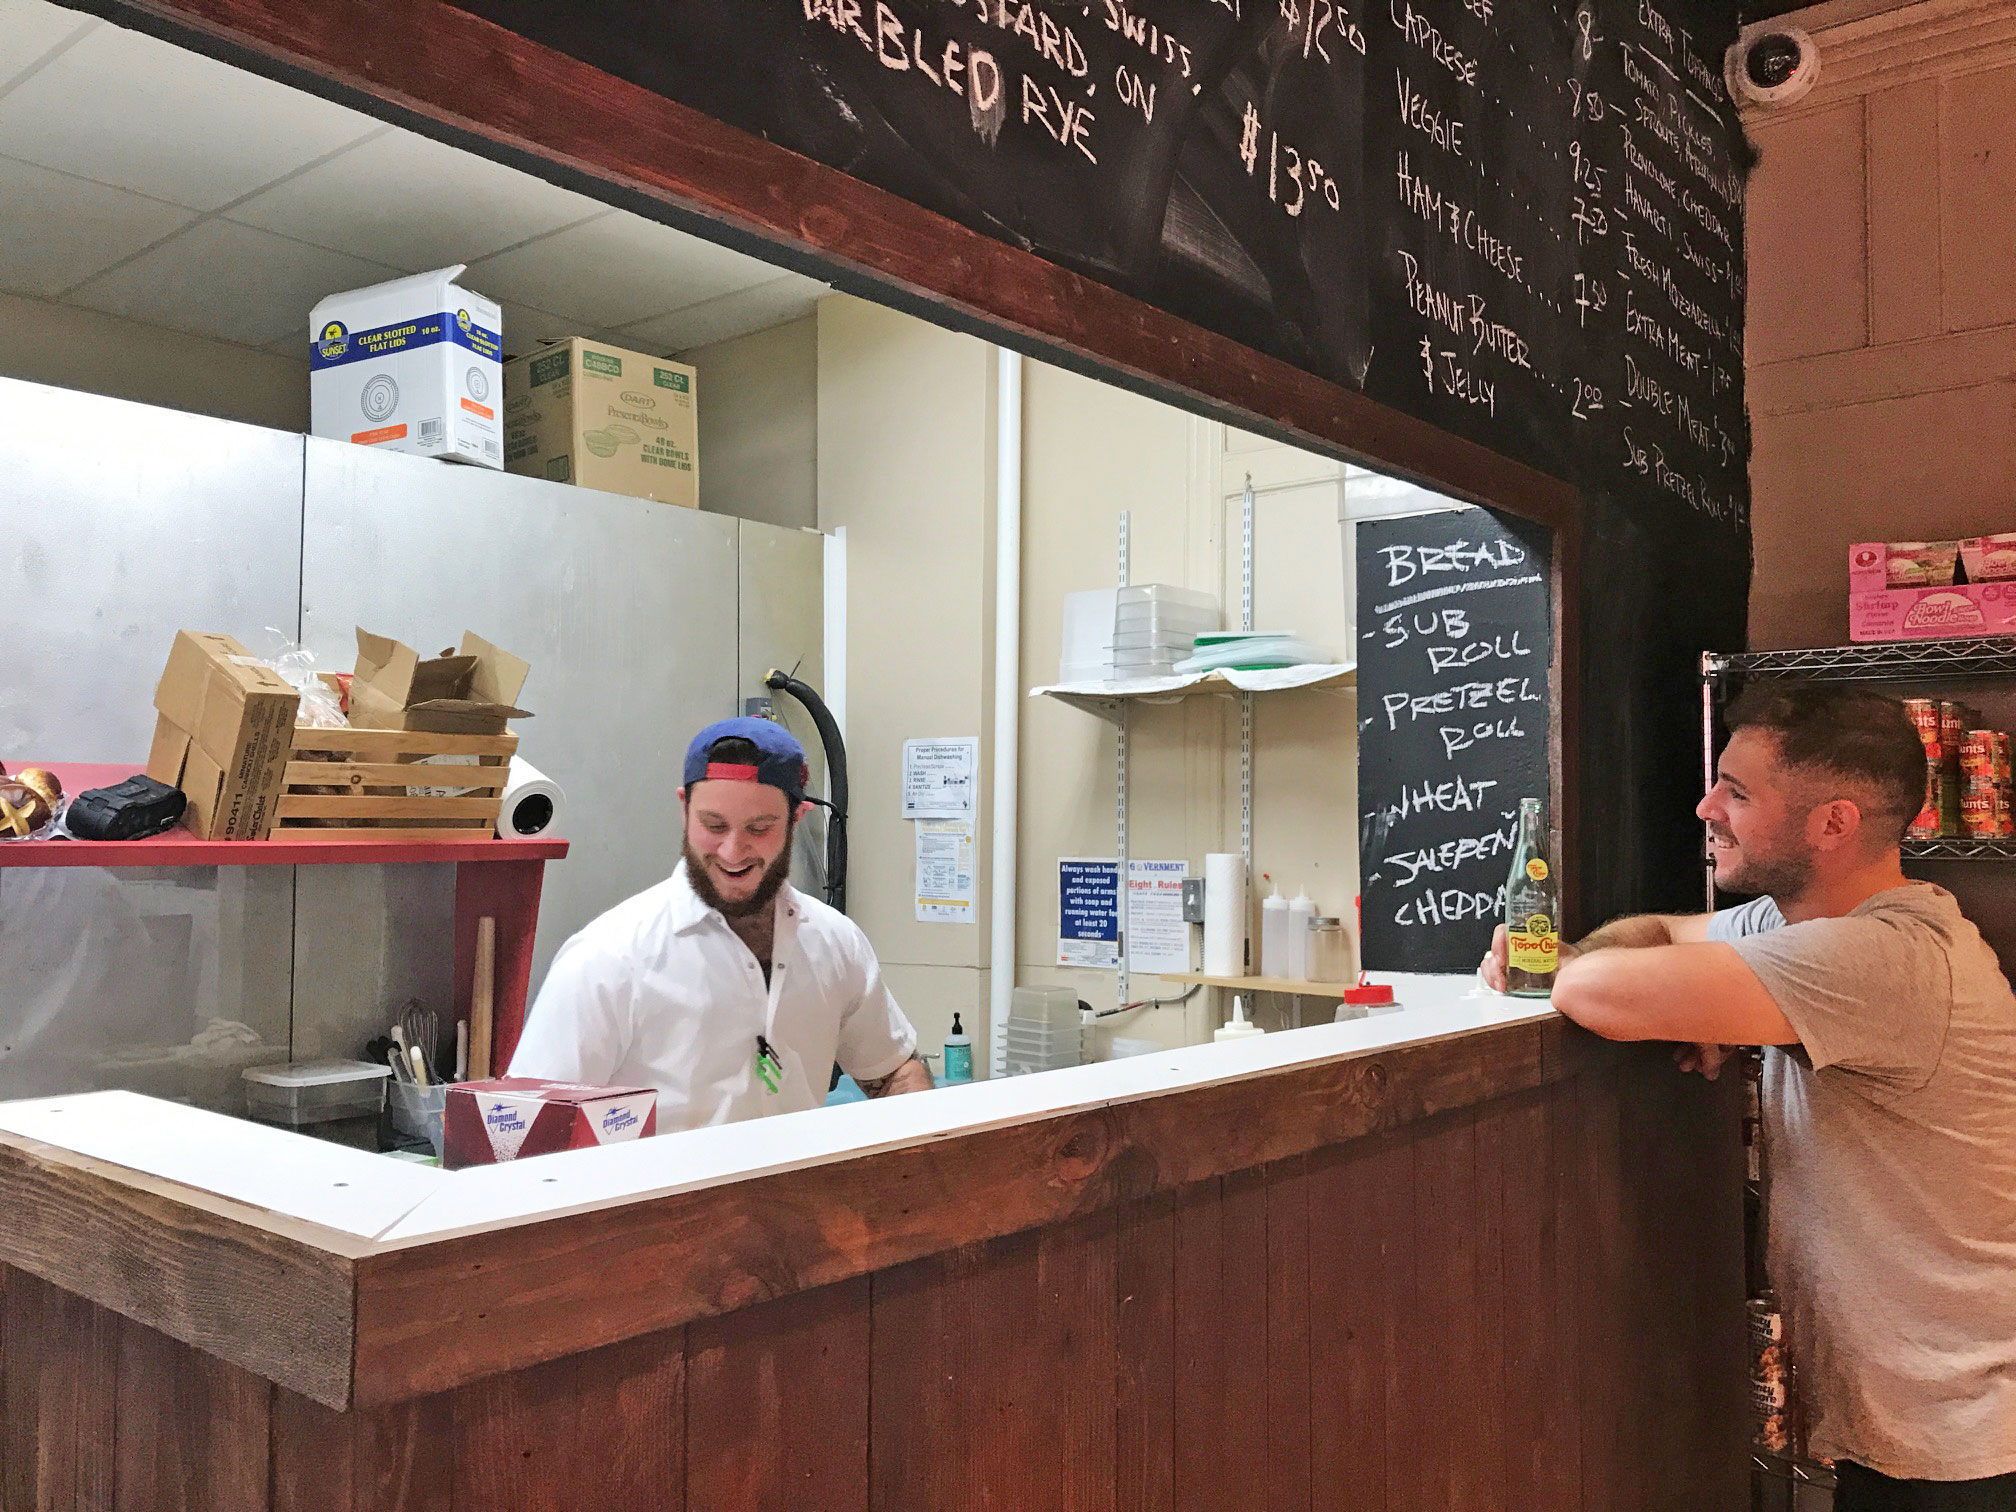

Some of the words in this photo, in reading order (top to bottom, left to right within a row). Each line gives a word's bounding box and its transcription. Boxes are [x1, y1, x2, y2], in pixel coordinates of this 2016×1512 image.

[1639, 0, 1675, 55] EXTRA
[1115, 64, 1157, 125] ON
[1396, 66, 1464, 156] VEGGIE
[1021, 72, 1098, 166] RYE
[1397, 150, 1443, 233] HAM
[1464, 210, 1524, 283] CHEESE
[1621, 230, 1661, 288] FRESH
[1397, 250, 1466, 336] PEANUT
[1467, 294, 1532, 371] BUTTER
[322, 343, 348, 358] SUNSET
[358, 334, 383, 347] CLEAR
[383, 325, 417, 341] SLOTTED
[421, 327, 430, 336] 10
[369, 340, 388, 353] FLAT
[389, 336, 407, 349] LIDS
[1626, 289, 1665, 352] EXTRA
[1667, 326, 1701, 378] MEAT
[1440, 351, 1495, 419] JELLY
[1678, 394, 1709, 452] MEAT
[1622, 425, 1649, 476] SUB
[1376, 537, 1526, 588] BREAD
[1382, 608, 1471, 649] SUB
[1913, 599, 1952, 619] Bowl
[1426, 629, 1531, 676] ROLL
[1381, 676, 1542, 732] PRETZEL
[1438, 715, 1526, 761] ROLL
[1061, 865, 1083, 874] Always
[1085, 866, 1101, 874] wash
[1102, 865, 1118, 874] hand
[1071, 876, 1084, 884] and
[1085, 877, 1111, 885] exposed
[1129, 880, 1152, 890] Eight
[1157, 879, 1183, 890] Rules
[1066, 887, 1092, 896] portions
[1092, 886, 1099, 895] of
[1100, 888, 1117, 896] arms
[1069, 897, 1084, 906] with
[1085, 898, 1099, 907] soap
[1100, 897, 1113, 906] and
[1394, 887, 1506, 926] CHEDDA
[1065, 908, 1089, 917] running
[1089, 909, 1107, 917] water
[1108, 908, 1118, 917] for
[1082, 918, 1099, 927] least
[1099, 919, 1108, 928] 20
[1510, 936, 1539, 953] Topo
[487, 1110, 518, 1125] Diamond
[499, 1120, 526, 1134] Crystal
[602, 1109, 631, 1129] Diamond
[614, 1115, 639, 1132] Crystal
